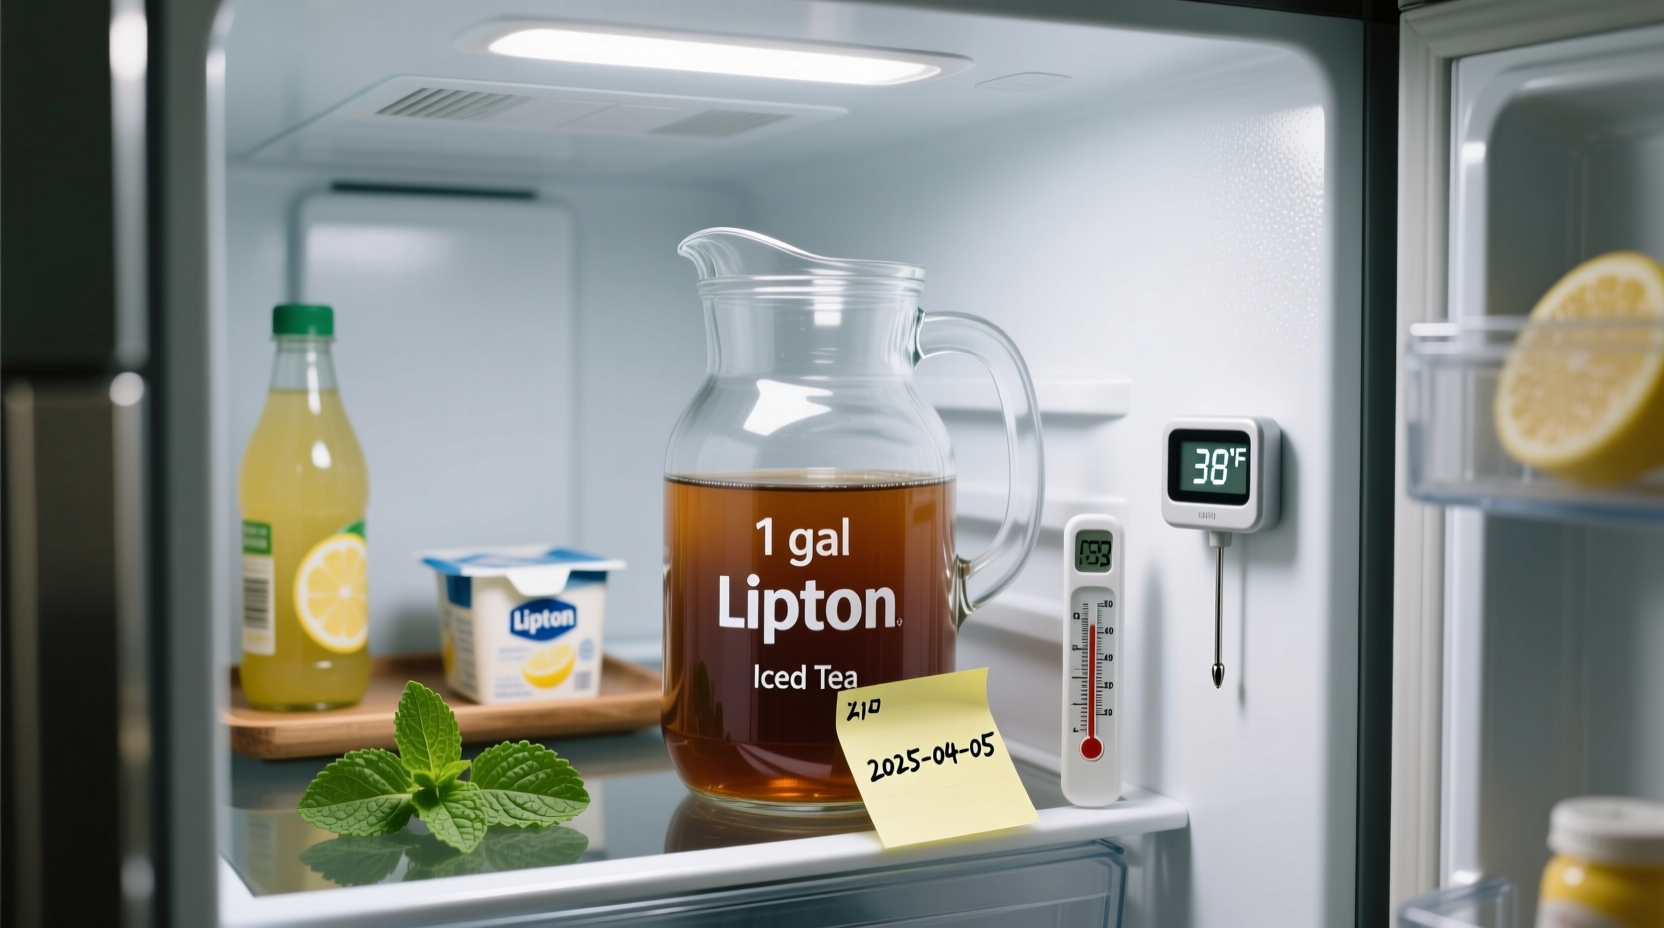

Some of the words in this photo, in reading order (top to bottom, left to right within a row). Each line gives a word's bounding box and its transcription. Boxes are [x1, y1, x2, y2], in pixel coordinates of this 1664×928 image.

[756, 517, 773, 556] 1
[789, 517, 850, 567] gal
[513, 608, 575, 635] Lipton
[719, 573, 896, 644] Lipton
[754, 664, 806, 690] Iced
[814, 664, 858, 690] Tea
[867, 731, 995, 782] 2025-04-05
